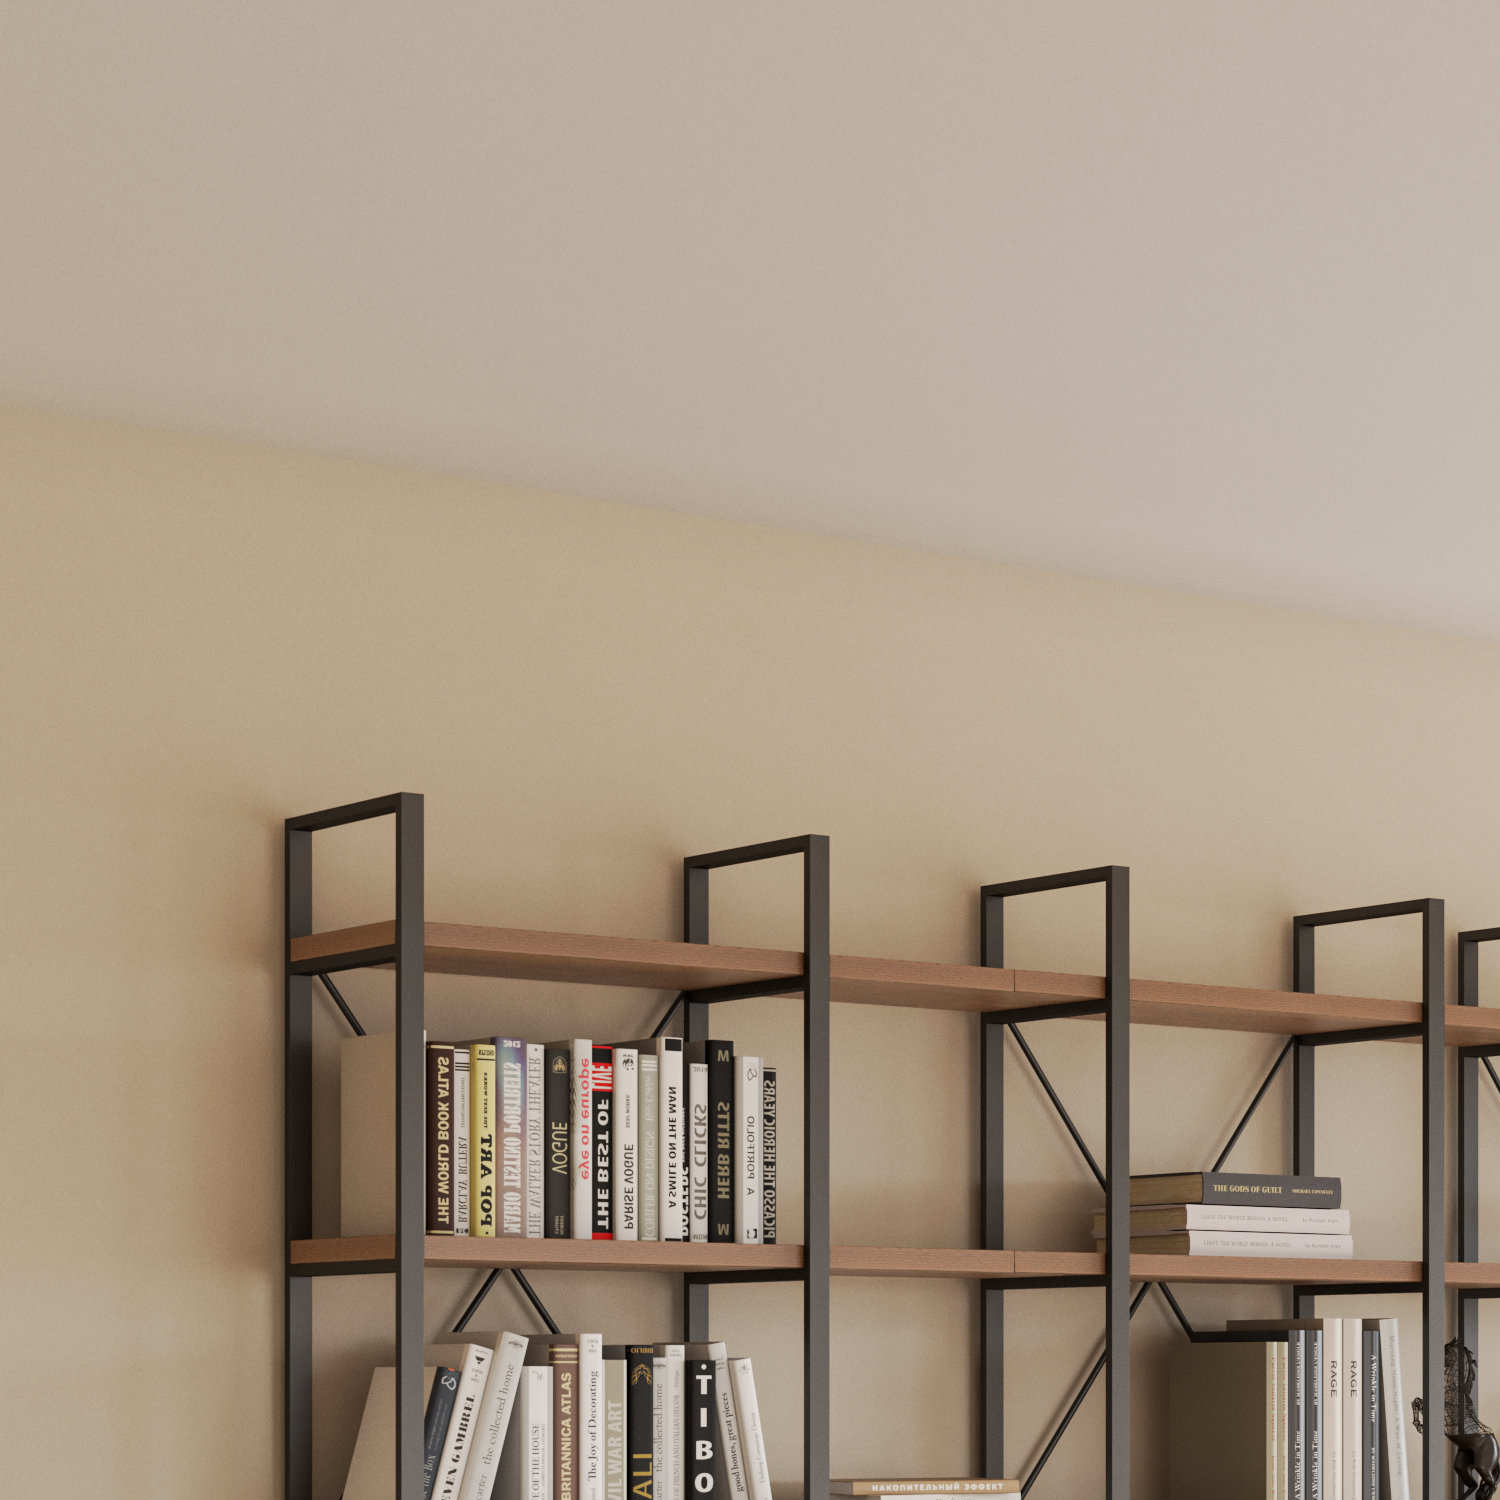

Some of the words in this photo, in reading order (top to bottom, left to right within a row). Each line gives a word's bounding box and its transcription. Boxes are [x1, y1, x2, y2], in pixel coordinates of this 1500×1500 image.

[1213, 1184, 1228, 1192] THE
[1229, 1185, 1249, 1193] GODS
[1250, 1185, 1261, 1193] OF
[1262, 1186, 1282, 1194] GUILT
[1330, 1360, 1338, 1398] RAGE
[1350, 1360, 1358, 1398] RAGE
[561, 1372, 572, 1414] ATLAS
[588, 1371, 599, 1427] Decorating
[722, 1392, 733, 1418] pieces
[452, 1394, 475, 1463] GAMBREL
[588, 1430, 597, 1442] of
[728, 1419, 738, 1442] great
[589, 1444, 599, 1462] Joy
[730, 1442, 741, 1471] bones,
[588, 1462, 597, 1481] The
[733, 1471, 745, 1493] good
[872, 1481, 961, 1492] НАКОПИТЕЛЬНЫЙ
[963, 1482, 1004, 1491] ЭФФЕКТ
